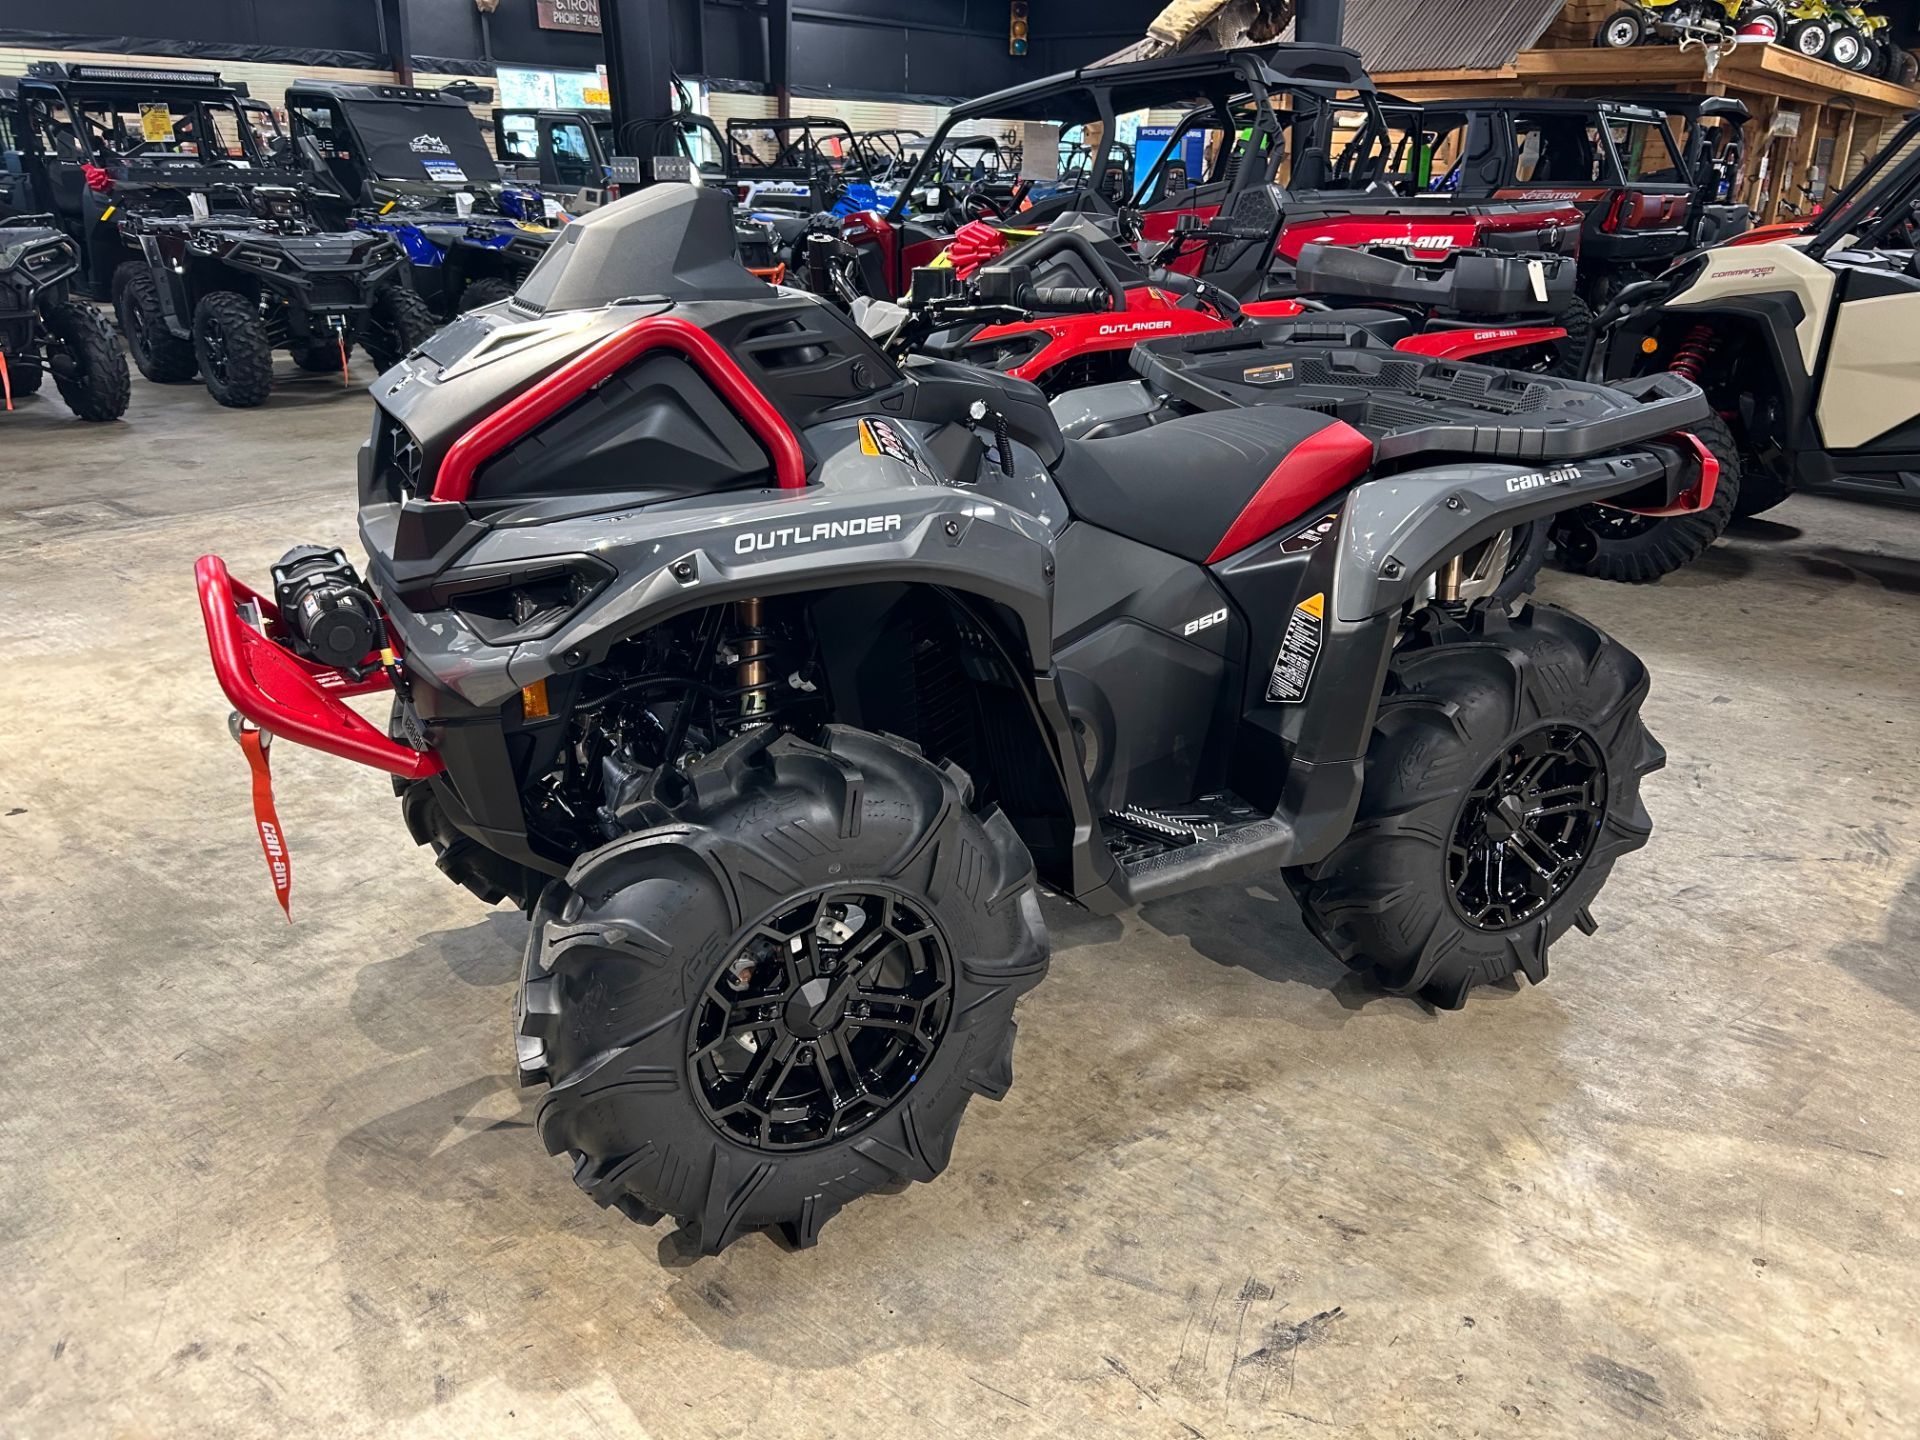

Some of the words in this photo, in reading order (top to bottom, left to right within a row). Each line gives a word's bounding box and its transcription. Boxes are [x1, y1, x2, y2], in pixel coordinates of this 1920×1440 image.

[553, 11, 581, 25] PHONE
[1099, 320, 1172, 335] OUTLANDER
[1474, 329, 1518, 341] can-am
[1505, 467, 1582, 493] can-am
[734, 513, 902, 555] OUTLANDER
[1184, 607, 1228, 636] 850
[261, 821, 288, 891] can-am
